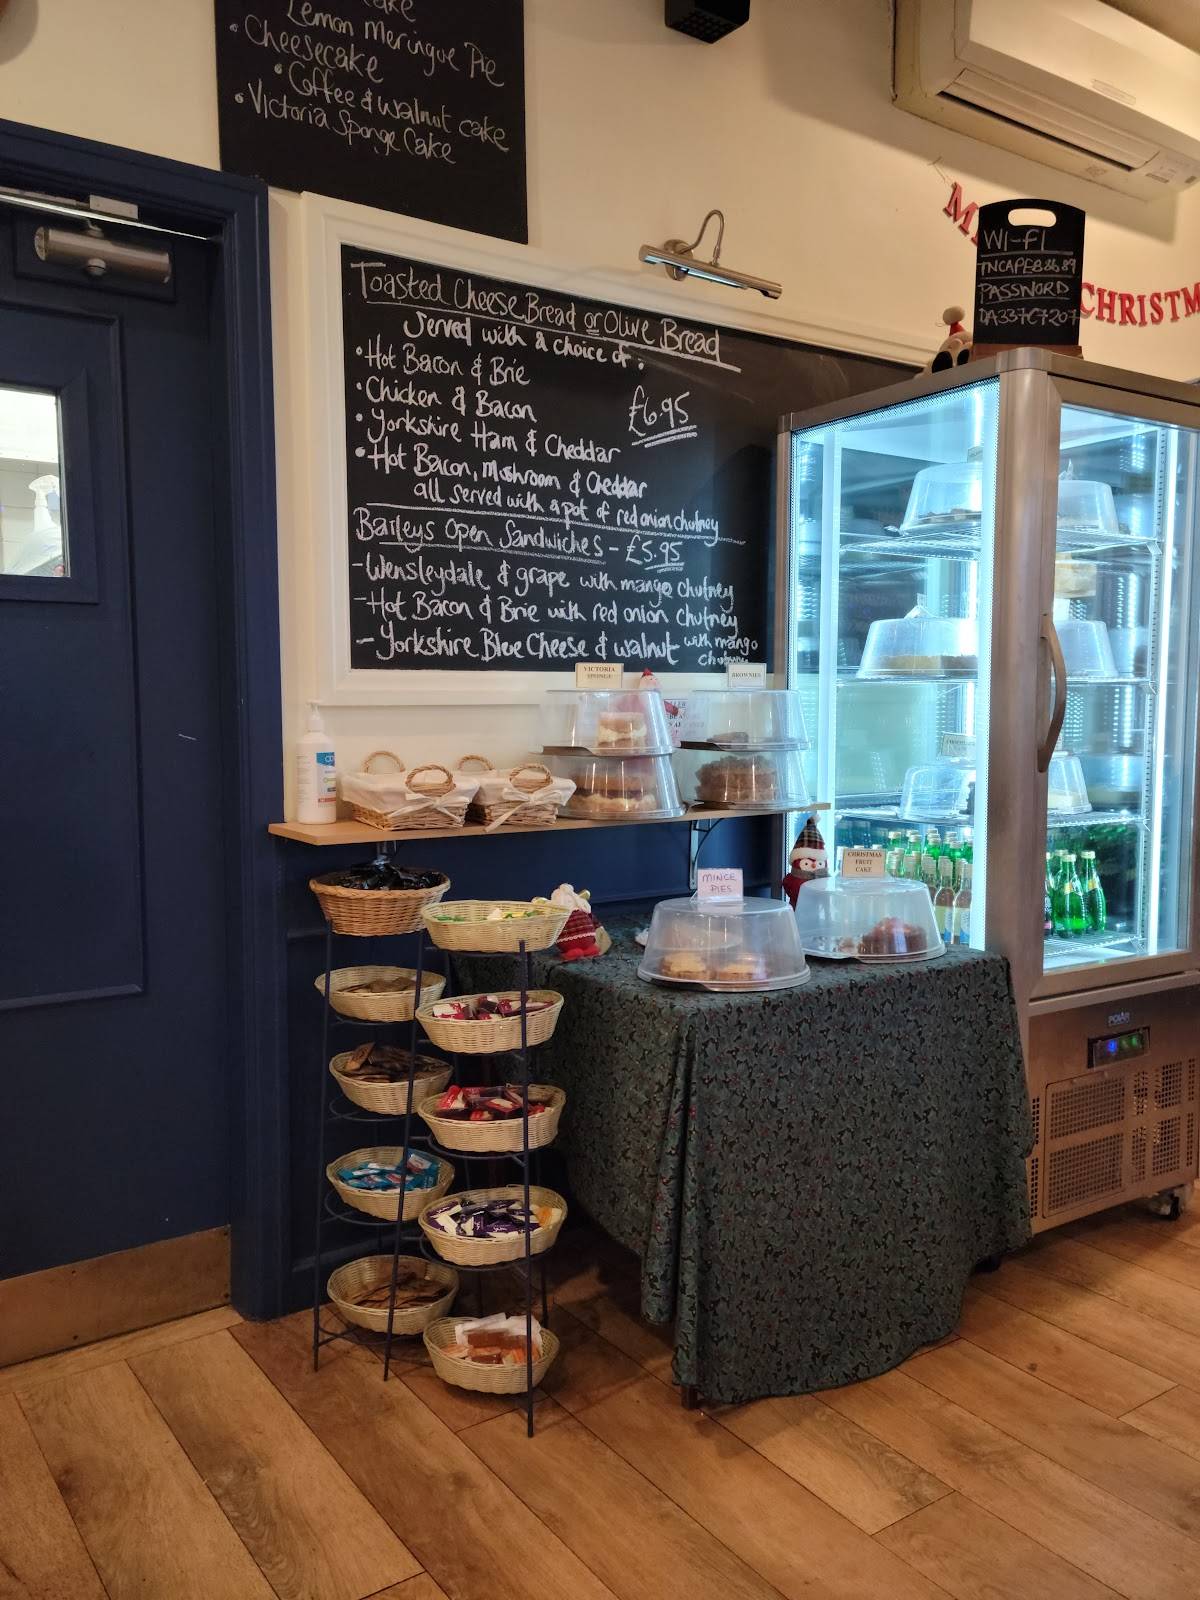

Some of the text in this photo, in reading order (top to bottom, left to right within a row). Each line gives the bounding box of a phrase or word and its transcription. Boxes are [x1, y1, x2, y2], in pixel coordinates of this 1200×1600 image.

[244, 14, 384, 83] Cheesecake
[287, 0, 354, 37] Lemon
[463, 41, 505, 87] Pie
[288, 60, 356, 108] Coffee
[360, 88, 373, 112] &
[248, 79, 330, 128] Victoria
[332, 108, 401, 156] Sponge
[943, 181, 979, 248] M
[350, 262, 721, 362] Toasted Cheese Bread or Olive Bread
[403, 310, 472, 346] Served
[482, 324, 527, 346] with
[535, 331, 549, 351] a
[553, 336, 607, 362] choice
[364, 333, 531, 386] Hot Bacon & Brie
[365, 375, 537, 423] Chicken & Bacon
[629, 385, 690, 437] £6.95
[367, 408, 621, 463] Yorkshire Ham & Cheddar
[367, 436, 406, 474] Hot
[413, 443, 478, 480] Bacon,
[569, 469, 580, 498] &
[586, 470, 648, 499] Cheddar
[413, 477, 445, 504] all
[506, 492, 544, 514] with
[561, 499, 589, 530] pot
[597, 499, 610, 519] of
[616, 505, 638, 526] red
[640, 508, 674, 530] onion
[674, 508, 720, 546] chutney
[445, 518, 492, 552] Open
[499, 518, 604, 558] Sandwiches
[625, 534, 682, 565] £5.95
[366, 551, 734, 613] Wensleydale & grape with mango chutney
[366, 586, 738, 638] Hot Bacon & Brie with red onion chutney
[375, 620, 758, 665] Yorkshire Blue Cheese & walnut with mango
[702, 873, 736, 882] MINCE
[709, 884, 732, 893] PIES
